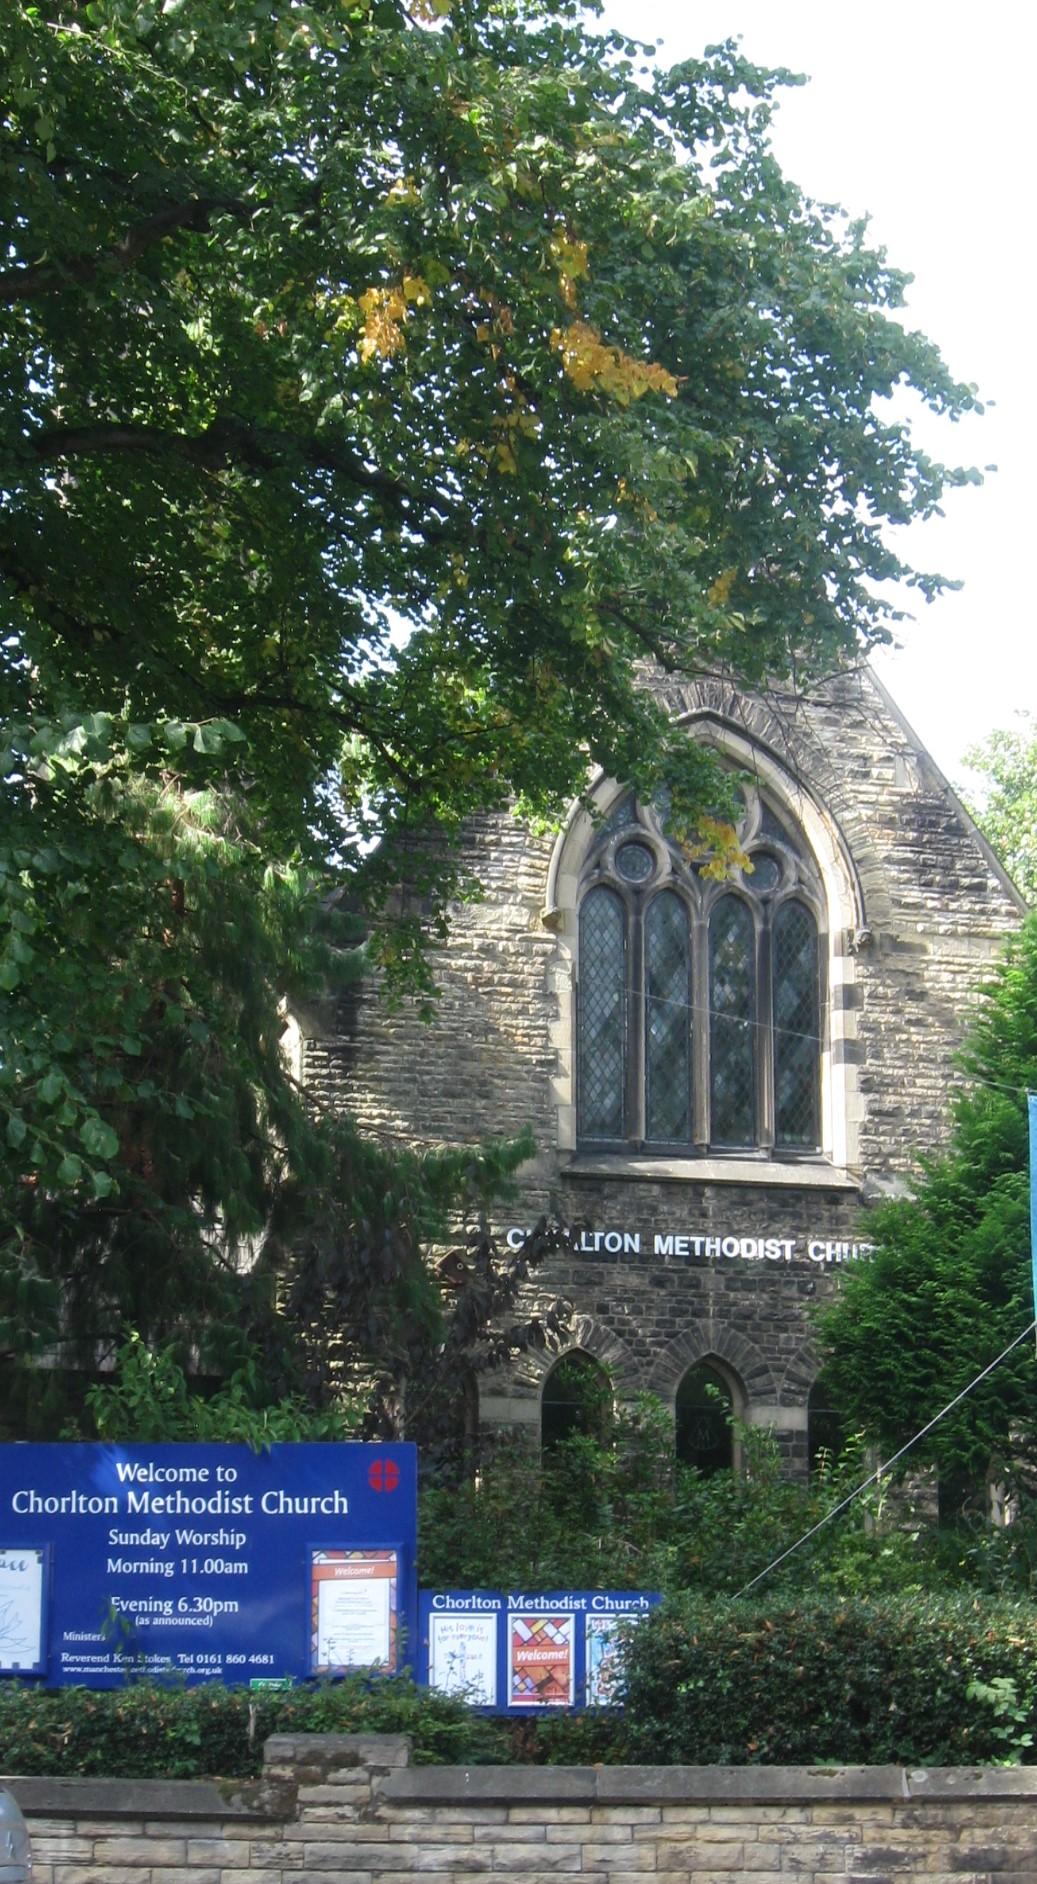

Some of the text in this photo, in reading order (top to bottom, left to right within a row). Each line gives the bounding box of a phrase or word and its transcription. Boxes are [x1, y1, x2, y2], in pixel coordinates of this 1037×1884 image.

[507, 1227, 877, 1263] CLTON METHODIST CHUR
[116, 1463, 237, 1482] Welcome to
[12, 1490, 349, 1514] Chorlton Methodist Church
[108, 1529, 246, 1549] Sunday Worship
[106, 1558, 248, 1577] Morning 11.00am
[334, 1566, 375, 1576] Welcome!
[111, 1596, 239, 1616] Evening 6.30pm
[432, 1595, 649, 1610] Chorlton Methodist Church
[135, 1615, 214, 1627] (as announced)
[61, 1653, 110, 1663] Reverend
[177, 1654, 194, 1664] Tel
[196, 1654, 222, 1664] 0161
[225, 1654, 246, 1664] 860
[248, 1654, 275, 1665] 4681
[516, 1649, 569, 1662] Welcome!
